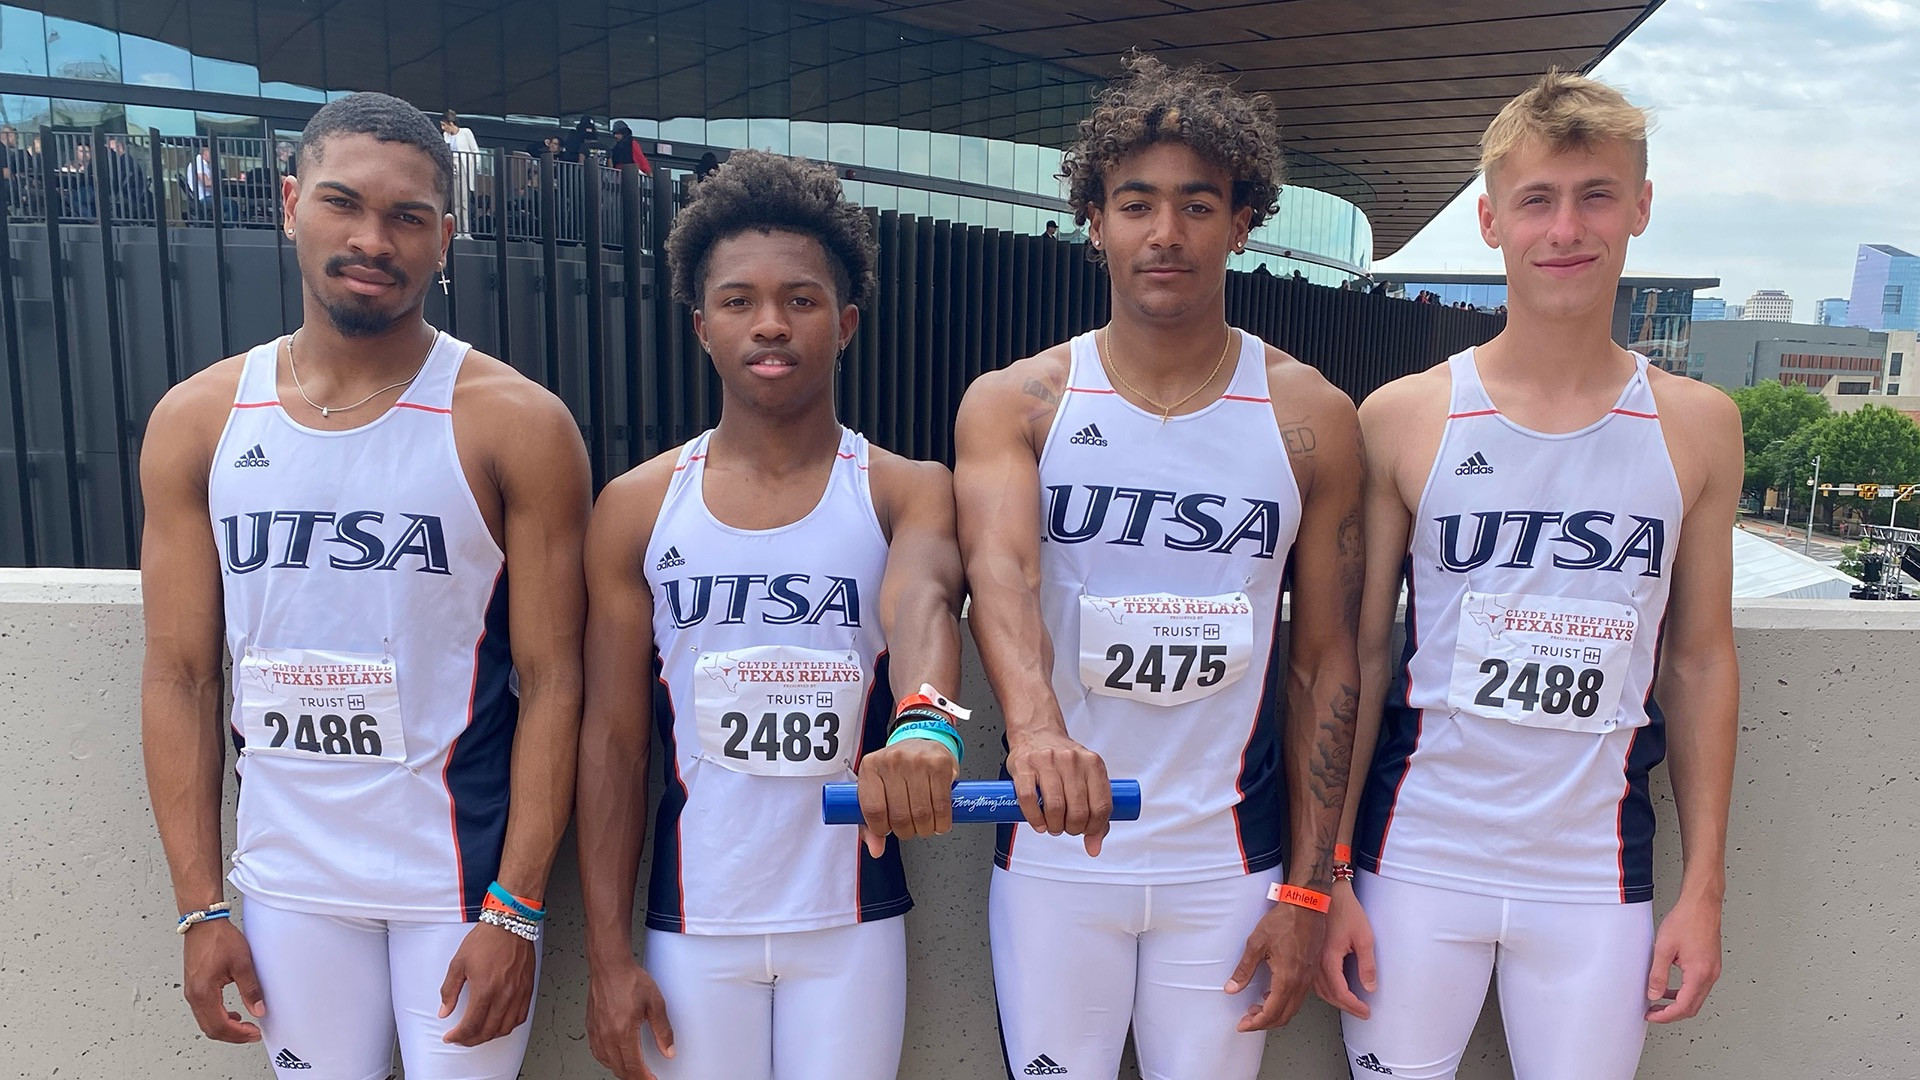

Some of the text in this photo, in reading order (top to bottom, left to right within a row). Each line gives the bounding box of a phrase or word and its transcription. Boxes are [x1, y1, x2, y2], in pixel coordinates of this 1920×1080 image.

[1070, 435, 1108, 447] adidas
[234, 457, 270, 468] adidas
[1455, 465, 1494, 476] adidas
[1046, 484, 1280, 560] UTSA
[219, 510, 453, 576] UTSA
[1433, 510, 1664, 578] UTSA
[656, 557, 686, 571] adidas
[660, 573, 862, 630] UTSA
[1124, 602, 1249, 615] TEXAS RELAYS
[1506, 609, 1634, 628] CLYDE LITTLEFIELD
[1153, 626, 1200, 637] TRUIST
[1504, 618, 1633, 642] TEXAS RELAYS
[1531, 644, 1581, 658] TRUIST
[271, 663, 392, 673] CLYDE LITTLEFIELD
[738, 661, 859, 670] CLYDE LITTLEFIELD
[1104, 643, 1227, 692] 2475
[272, 671, 393, 686] TEXAS RELAYS
[737, 669, 860, 683] TEXAS RELAYS
[1474, 658, 1604, 718] 2488
[299, 697, 344, 708] TRUIST
[766, 694, 813, 705] TRUIST
[264, 711, 383, 757] 2486
[720, 711, 840, 762] 2483
[952, 794, 1019, 812] EverythingTrac
[1285, 889, 1319, 906] Athlete
[275, 1059, 312, 1070] adidas
[1023, 1066, 1068, 1075] adidas
[1356, 1058, 1393, 1075] adidas
